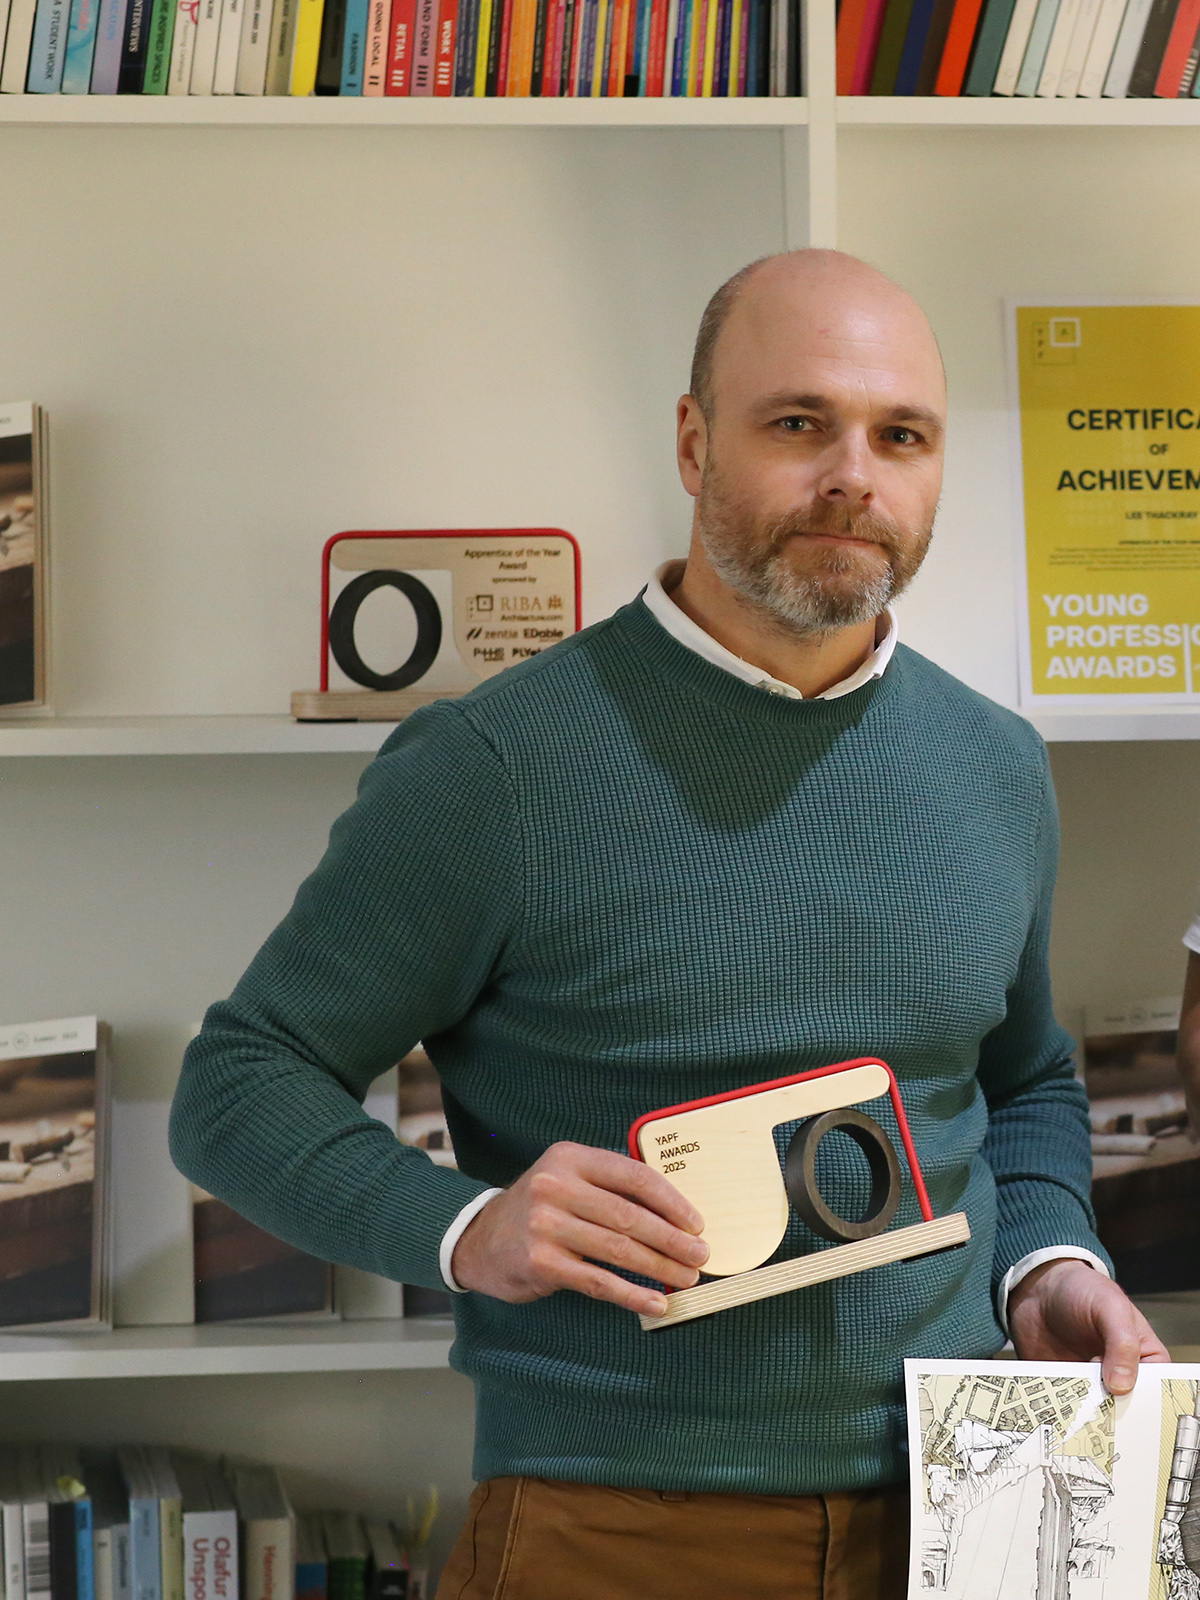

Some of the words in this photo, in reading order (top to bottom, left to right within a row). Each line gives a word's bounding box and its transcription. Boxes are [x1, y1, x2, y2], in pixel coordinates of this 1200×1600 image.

[128, 0, 143, 52] NTERVIEWS
[373, 2, 384, 32] GOING
[394, 23, 407, 61] RETAIL
[419, 26, 431, 56] FORM
[441, 20, 453, 54] WORK
[371, 36, 382, 66] LOCAL
[44, 53, 57, 80] WORK
[1149, 444, 1168, 455] OF
[1125, 511, 1142, 520] LEE
[464, 549, 512, 559] Apprentice
[514, 549, 524, 557] of
[527, 548, 541, 557] the
[543, 549, 561, 557] Year
[498, 561, 528, 570] Award
[500, 597, 542, 611] RIBA
[1043, 594, 1149, 617] YOUNG
[485, 629, 518, 639] zentia
[1046, 656, 1177, 679] AWARDS
[655, 1132, 679, 1146] YAPF
[660, 1141, 701, 1160] AWARDS
[662, 1160, 687, 1174] 2025
[190, 1537, 209, 1600] Unspo
[213, 1537, 230, 1597] Olafur
